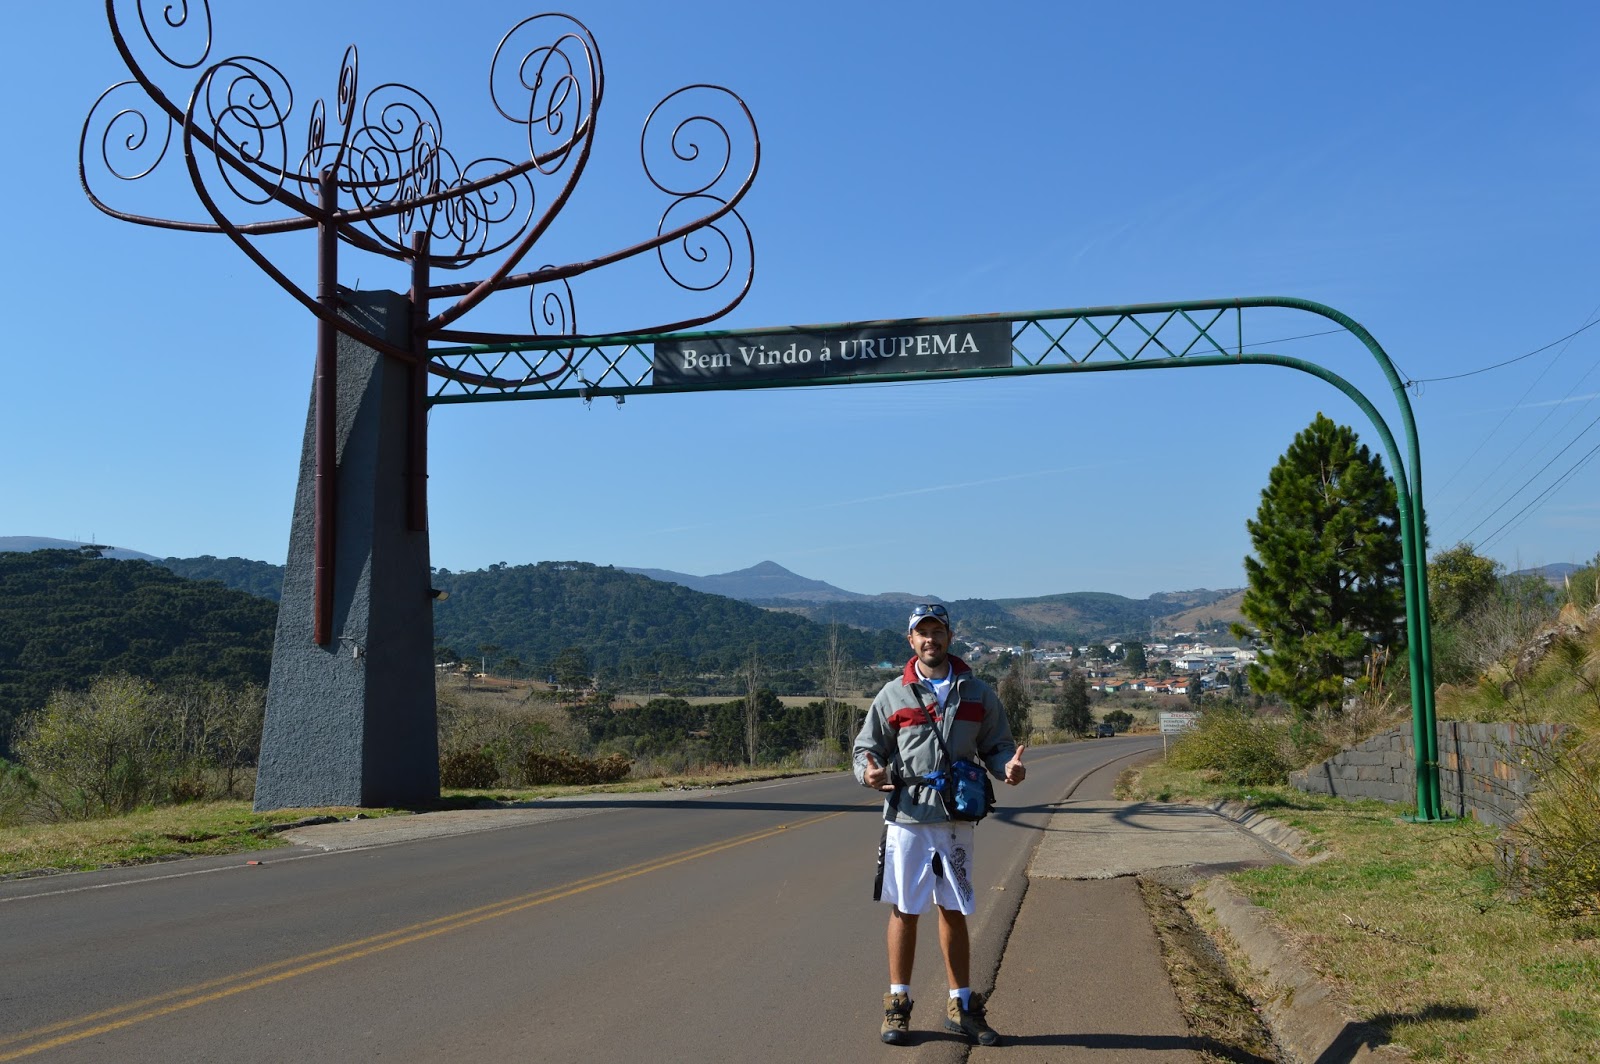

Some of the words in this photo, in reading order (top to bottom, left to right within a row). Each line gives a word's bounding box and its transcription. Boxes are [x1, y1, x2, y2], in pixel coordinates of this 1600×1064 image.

[683, 349, 732, 369] Bem
[738, 344, 812, 366] Vindo
[819, 346, 832, 361] a
[839, 333, 980, 360] URUPEMA
